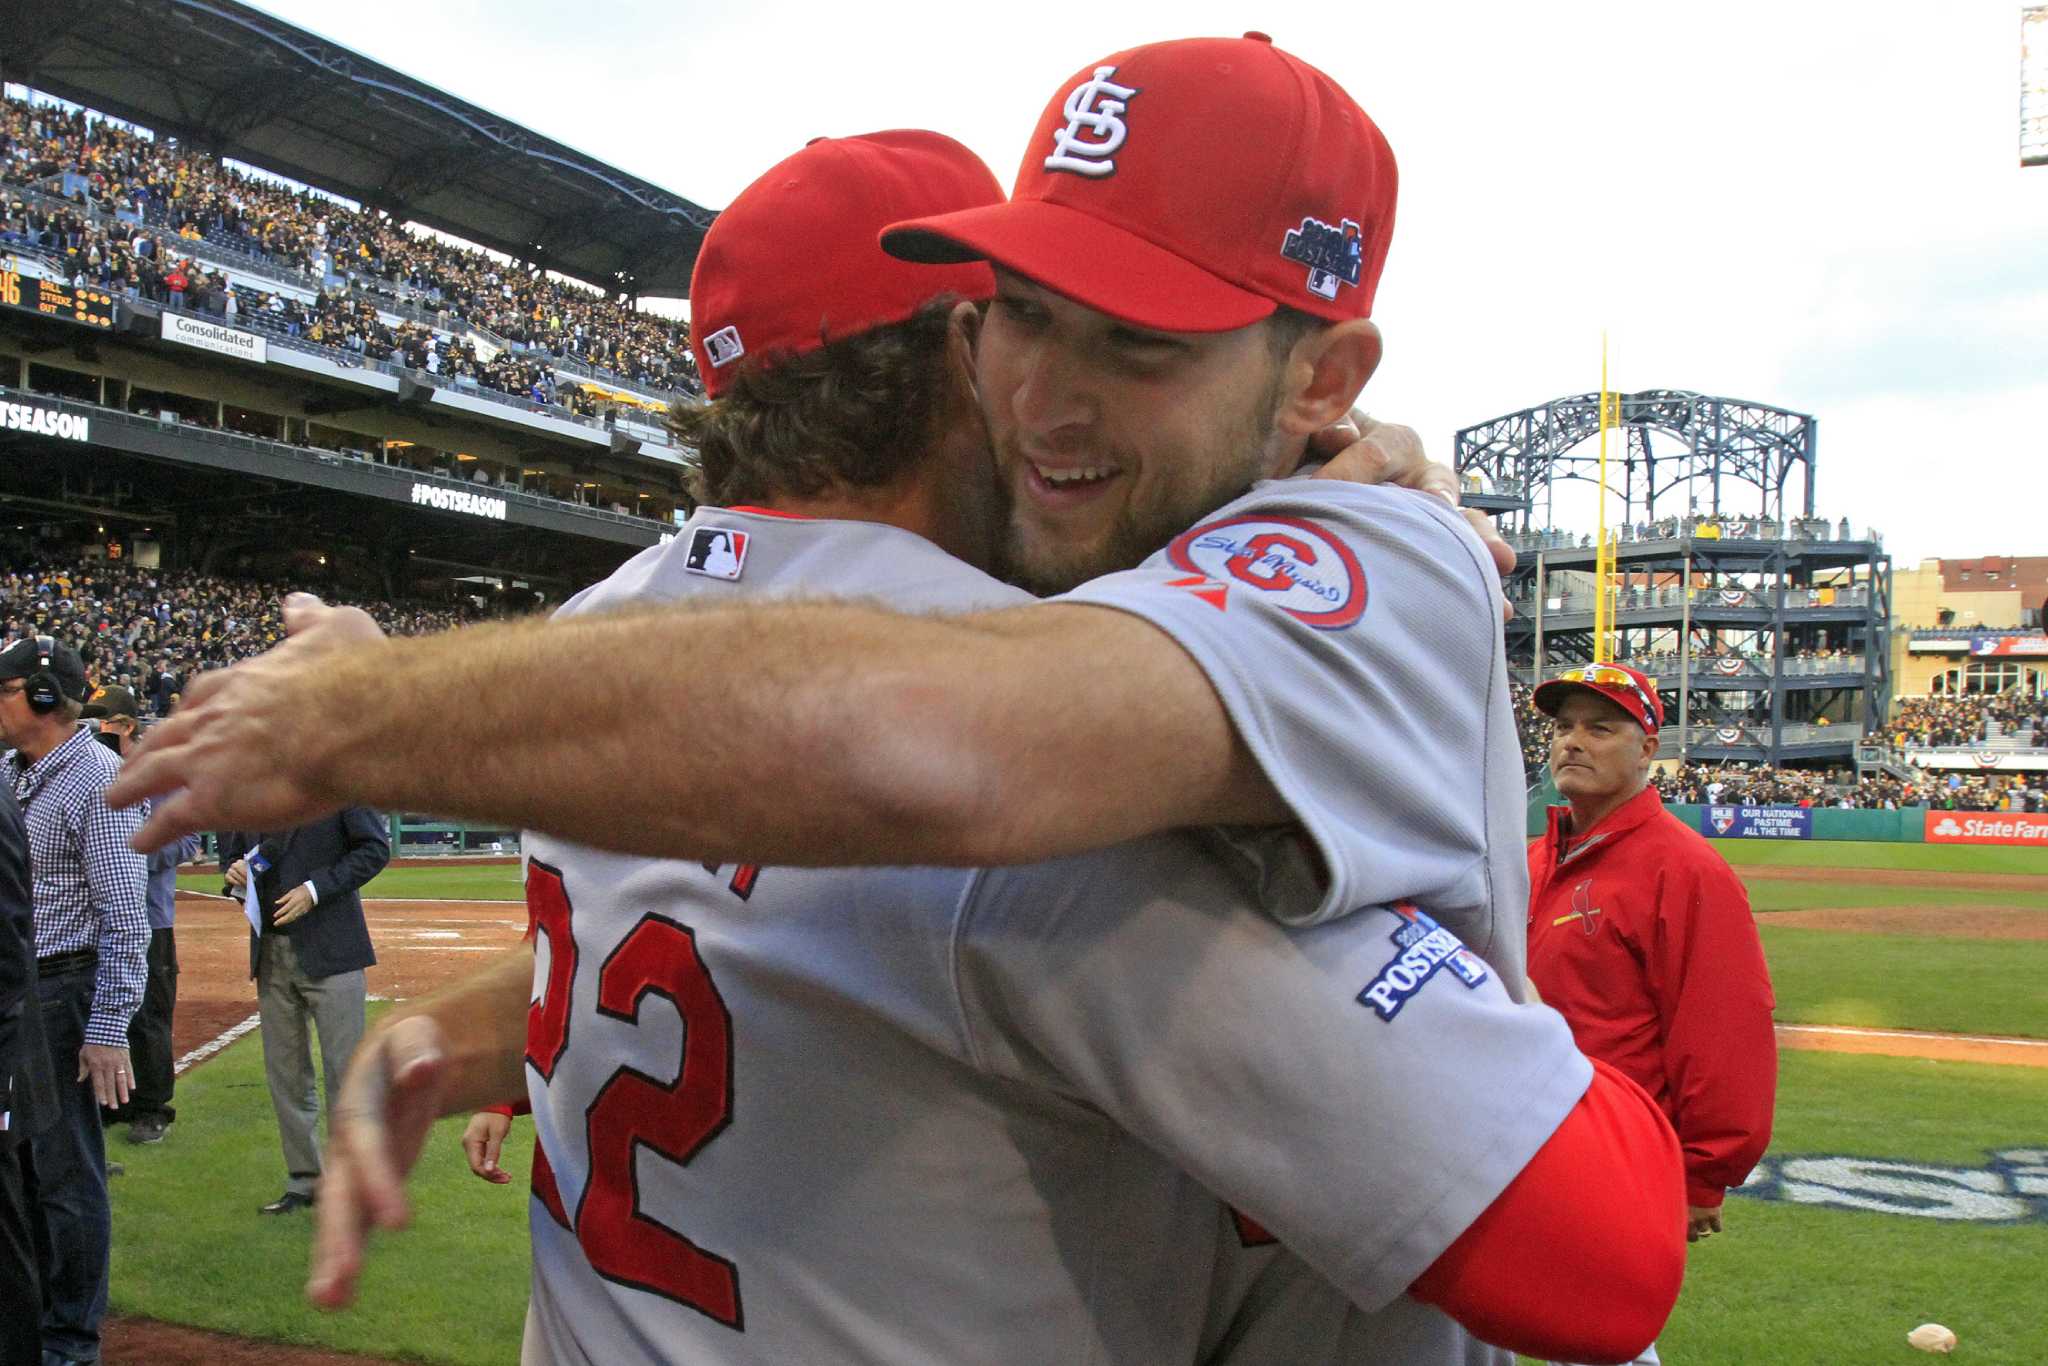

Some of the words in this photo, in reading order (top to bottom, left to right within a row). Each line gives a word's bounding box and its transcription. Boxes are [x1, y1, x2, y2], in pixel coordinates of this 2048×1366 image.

[40, 279, 62, 294] BALL
[40, 291, 72, 308] STRIKE
[40, 302, 57, 314] OUT
[176, 319, 253, 348] Consolidated
[175, 334, 253, 359] communications
[411, 483, 506, 520] #POSTSEASON
[91, 689, 106, 701] P
[1741, 808, 1760, 818] OUR
[1762, 809, 1805, 819] NATIONAL
[1754, 818, 1793, 827] PASTIME
[1964, 819, 2013, 838] State
[1743, 827, 1759, 836] ALL
[1760, 828, 1777, 836] THE
[1779, 828, 1801, 837] TIME
